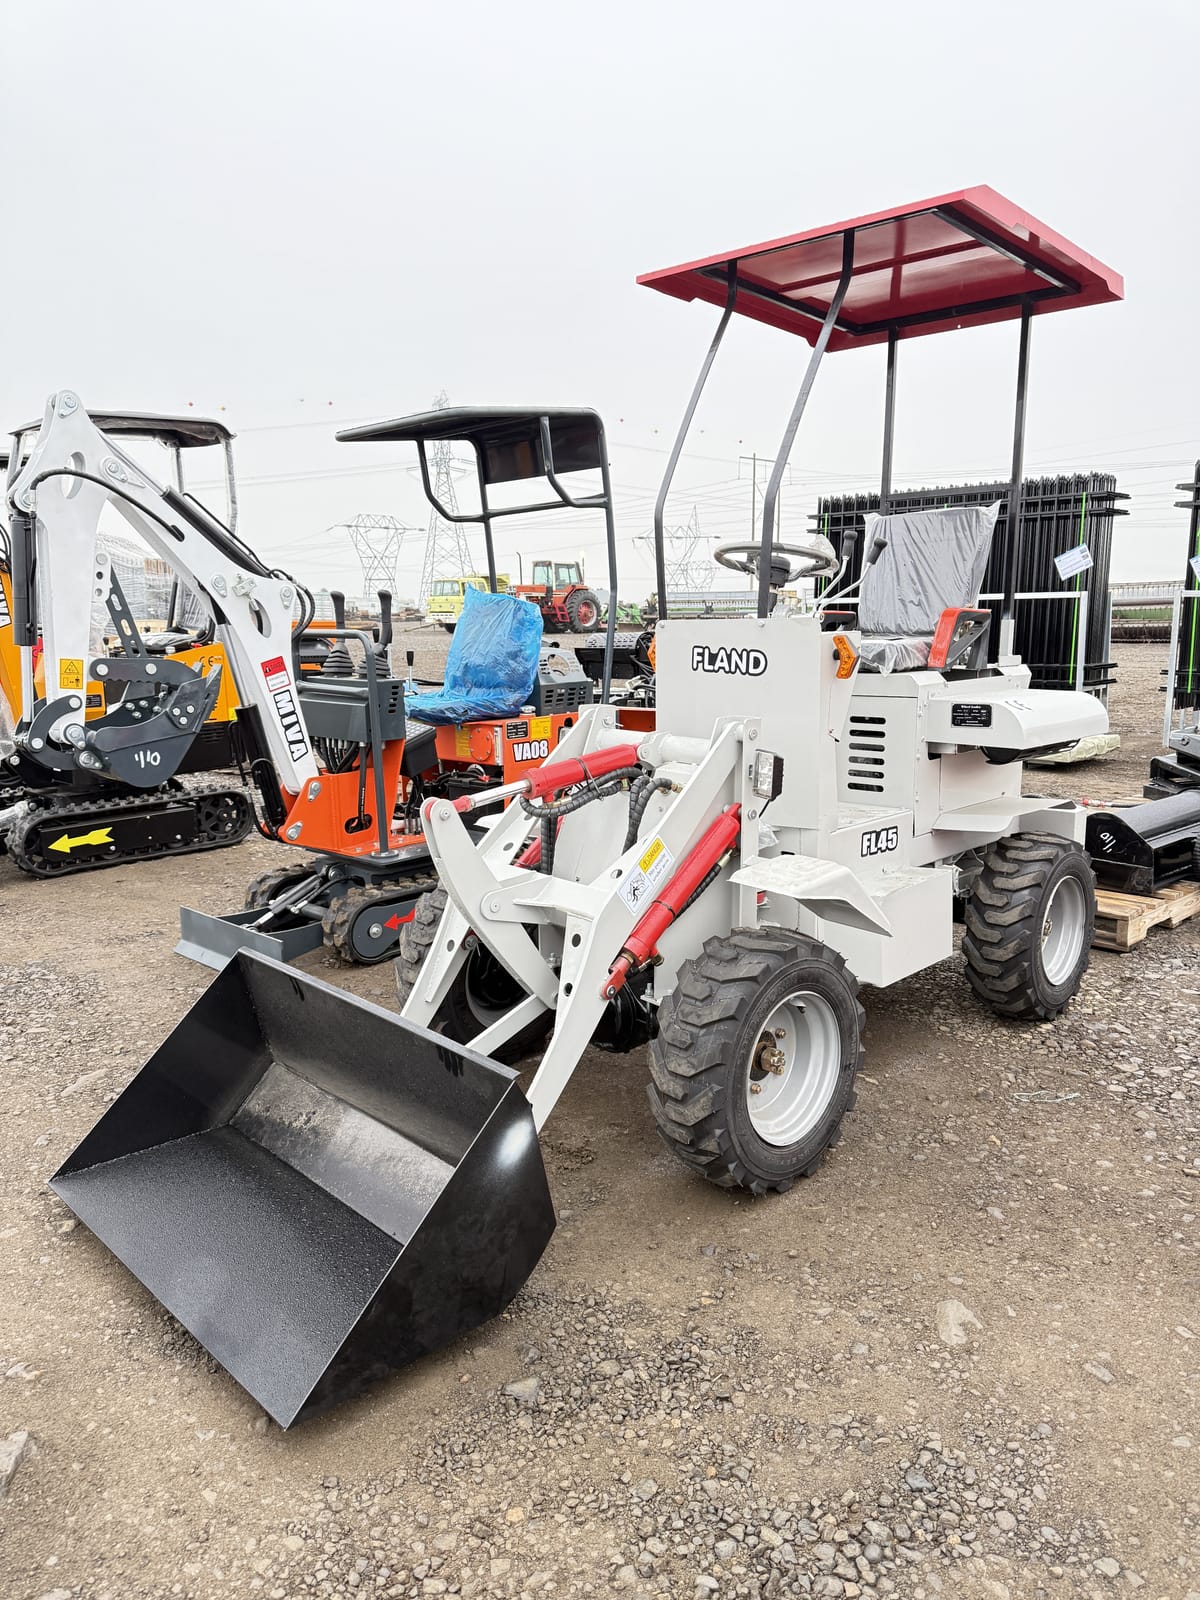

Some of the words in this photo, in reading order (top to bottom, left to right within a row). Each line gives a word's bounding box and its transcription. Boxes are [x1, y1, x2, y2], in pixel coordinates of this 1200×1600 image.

[692, 645, 767, 676] FLAND
[273, 689, 308, 762] MIVA
[512, 738, 550, 762] VA08
[860, 825, 899, 857] FL45
